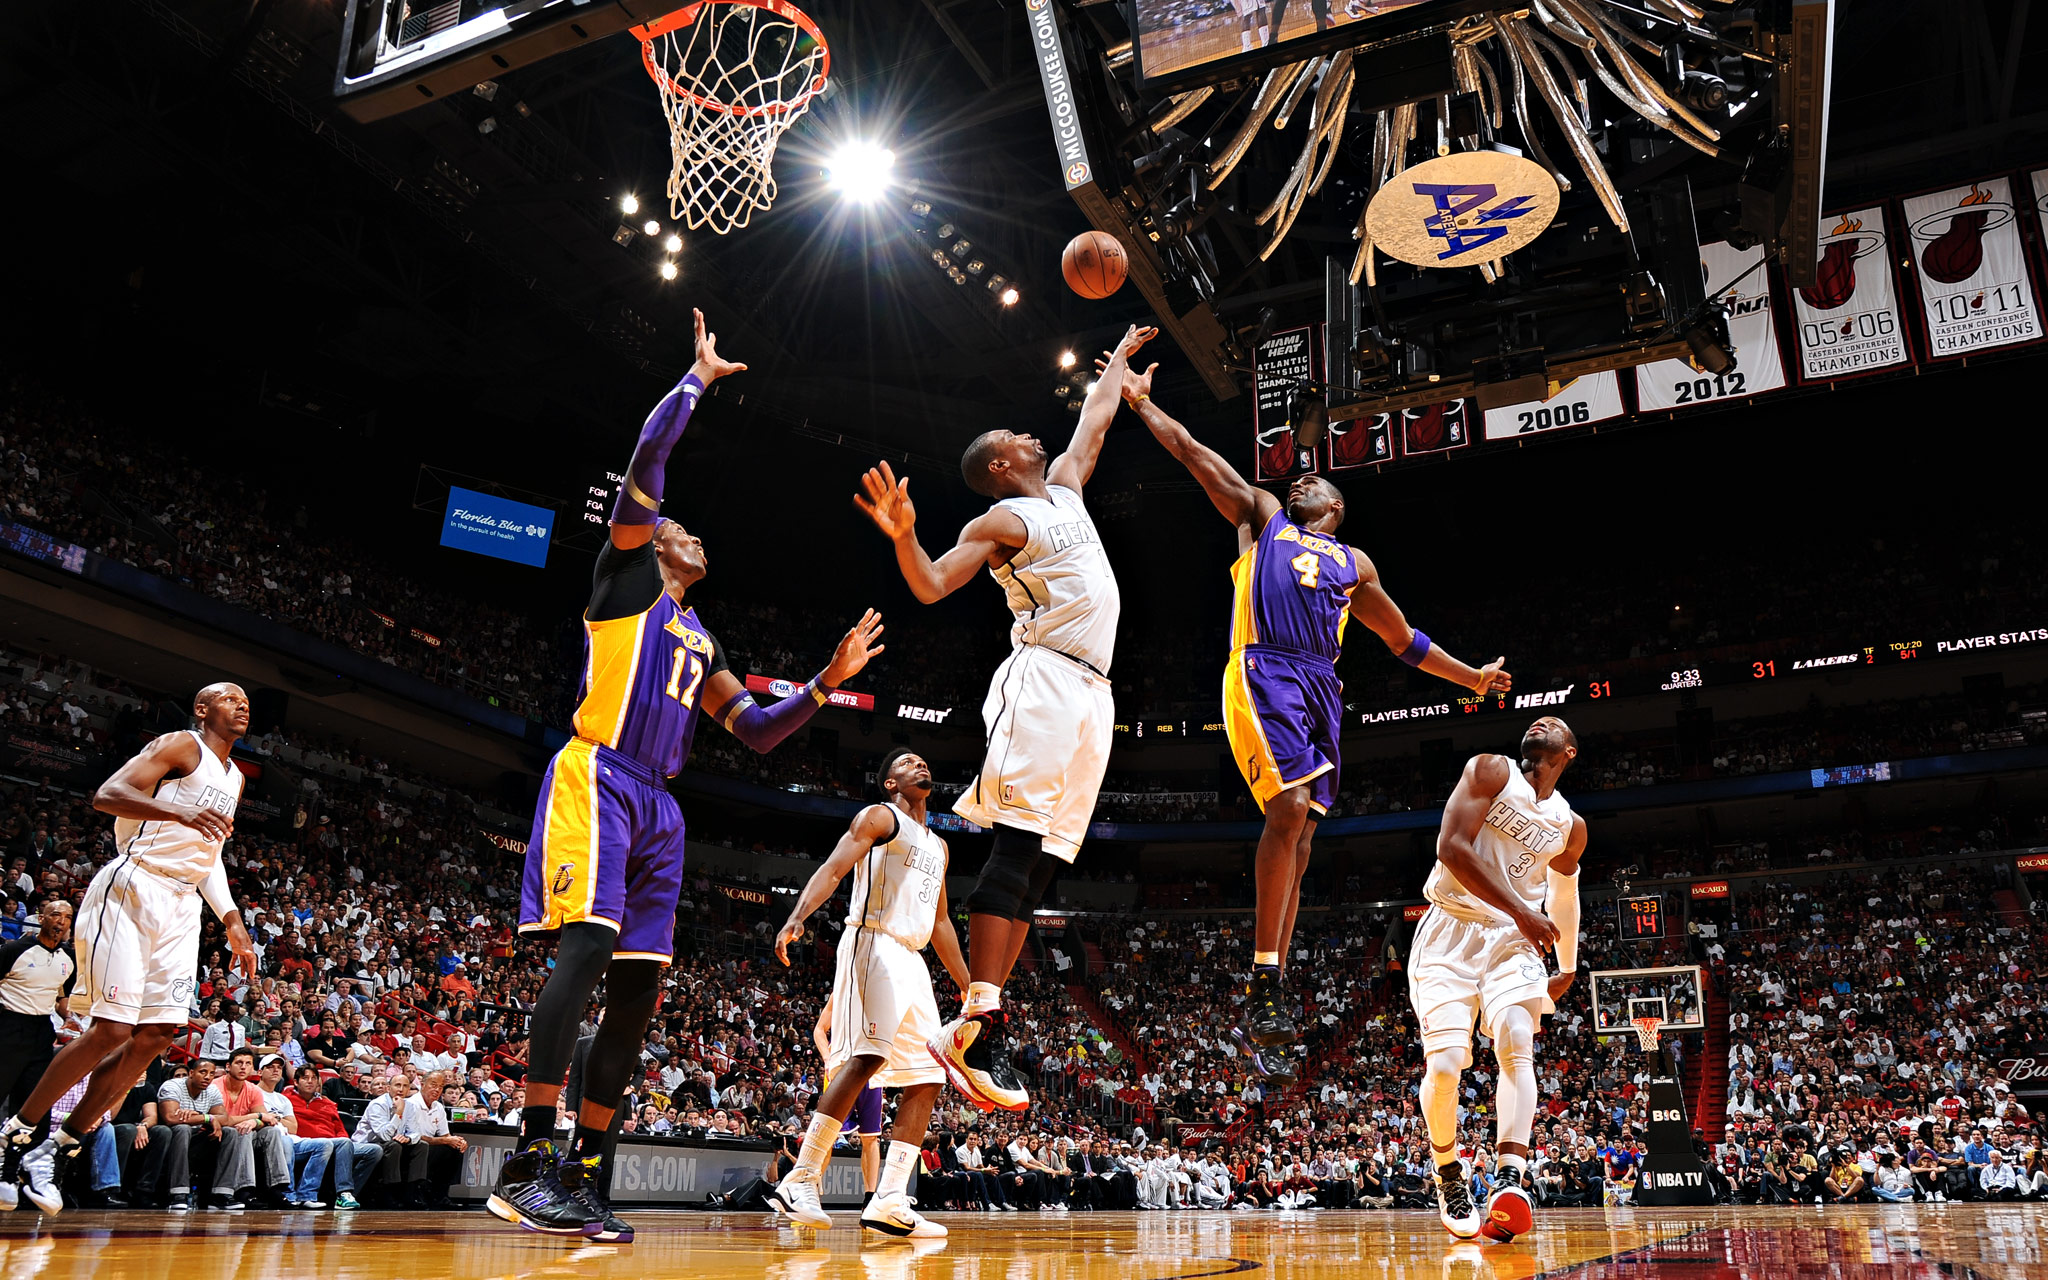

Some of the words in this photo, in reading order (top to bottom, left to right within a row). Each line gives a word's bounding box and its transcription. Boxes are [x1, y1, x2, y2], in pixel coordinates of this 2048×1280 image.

[1035, 9, 1081, 161] MICCOSUKEE.COM
[1438, 208, 1460, 240] ARENA
[1933, 295, 1969, 323] 10
[1993, 284, 2025, 312] 11
[1804, 321, 1837, 347] 05
[1858, 311, 1894, 337] 06
[1936, 322, 1974, 335] EASTERN
[1976, 310, 2029, 326] CONFERENCE
[1260, 334, 1300, 350] MIAMI
[1937, 321, 2034, 350] CHAMPIONS
[1267, 340, 1304, 357] HEAT
[1808, 347, 1843, 358] EASTERN
[1845, 337, 1897, 353] CONFERENCE
[1257, 355, 1308, 371] ATLANTIC
[1809, 347, 1900, 373] CHAMPIONS
[1674, 373, 1746, 404] 2012
[1518, 401, 1590, 434] 2006
[589, 486, 608, 498] FGM
[586, 500, 604, 511] FGA
[452, 508, 497, 527] Florida
[497, 519, 523, 533] Blue
[584, 513, 603, 524] FG%
[457, 522, 468, 530] the
[468, 525, 489, 535] pursuit
[496, 532, 515, 540] health
[1291, 551, 1320, 589] 4
[1792, 653, 1859, 670] LAKERS
[1863, 647, 1874, 655] TF
[1937, 635, 1996, 652] PLAYER
[1999, 629, 2048, 645] STATS
[1866, 654, 1874, 664] 2
[1900, 649, 1917, 660] 5/1
[665, 646, 703, 711] 12
[1670, 669, 1701, 683] 9:33
[1752, 660, 1776, 679] 31
[774, 682, 790, 692] FOX
[1589, 681, 1611, 699] 31
[1661, 679, 1697, 691] QUARTER
[1697, 679, 1703, 687] 2
[897, 703, 952, 723] HEAT
[1362, 708, 1409, 724] PLAYER
[1410, 704, 1450, 718] STATS
[1514, 684, 1575, 709] HEAT
[1464, 704, 1478, 713] 5/1
[1498, 700, 1505, 709] 0
[1114, 724, 1130, 732] PTS
[1157, 724, 1173, 732] REB
[1202, 723, 1227, 731] ASSTS
[1137, 721, 1143, 730] 2
[1182, 720, 1186, 728] 1
[1137, 729, 1143, 738] 6
[1182, 728, 1186, 736] 1
[1149, 792, 1182, 801] Location
[1193, 792, 1216, 800] 69050
[1485, 801, 1560, 853] HEAT
[1508, 852, 1536, 879] 3
[1691, 885, 1728, 895] BACARDI
[1630, 900, 1658, 913] 9:33
[1034, 918, 1066, 926] BACARDI
[1636, 914, 1657, 934] 14
[1656, 1172, 1685, 1187] NBA
[1685, 1171, 1703, 1186] TV
